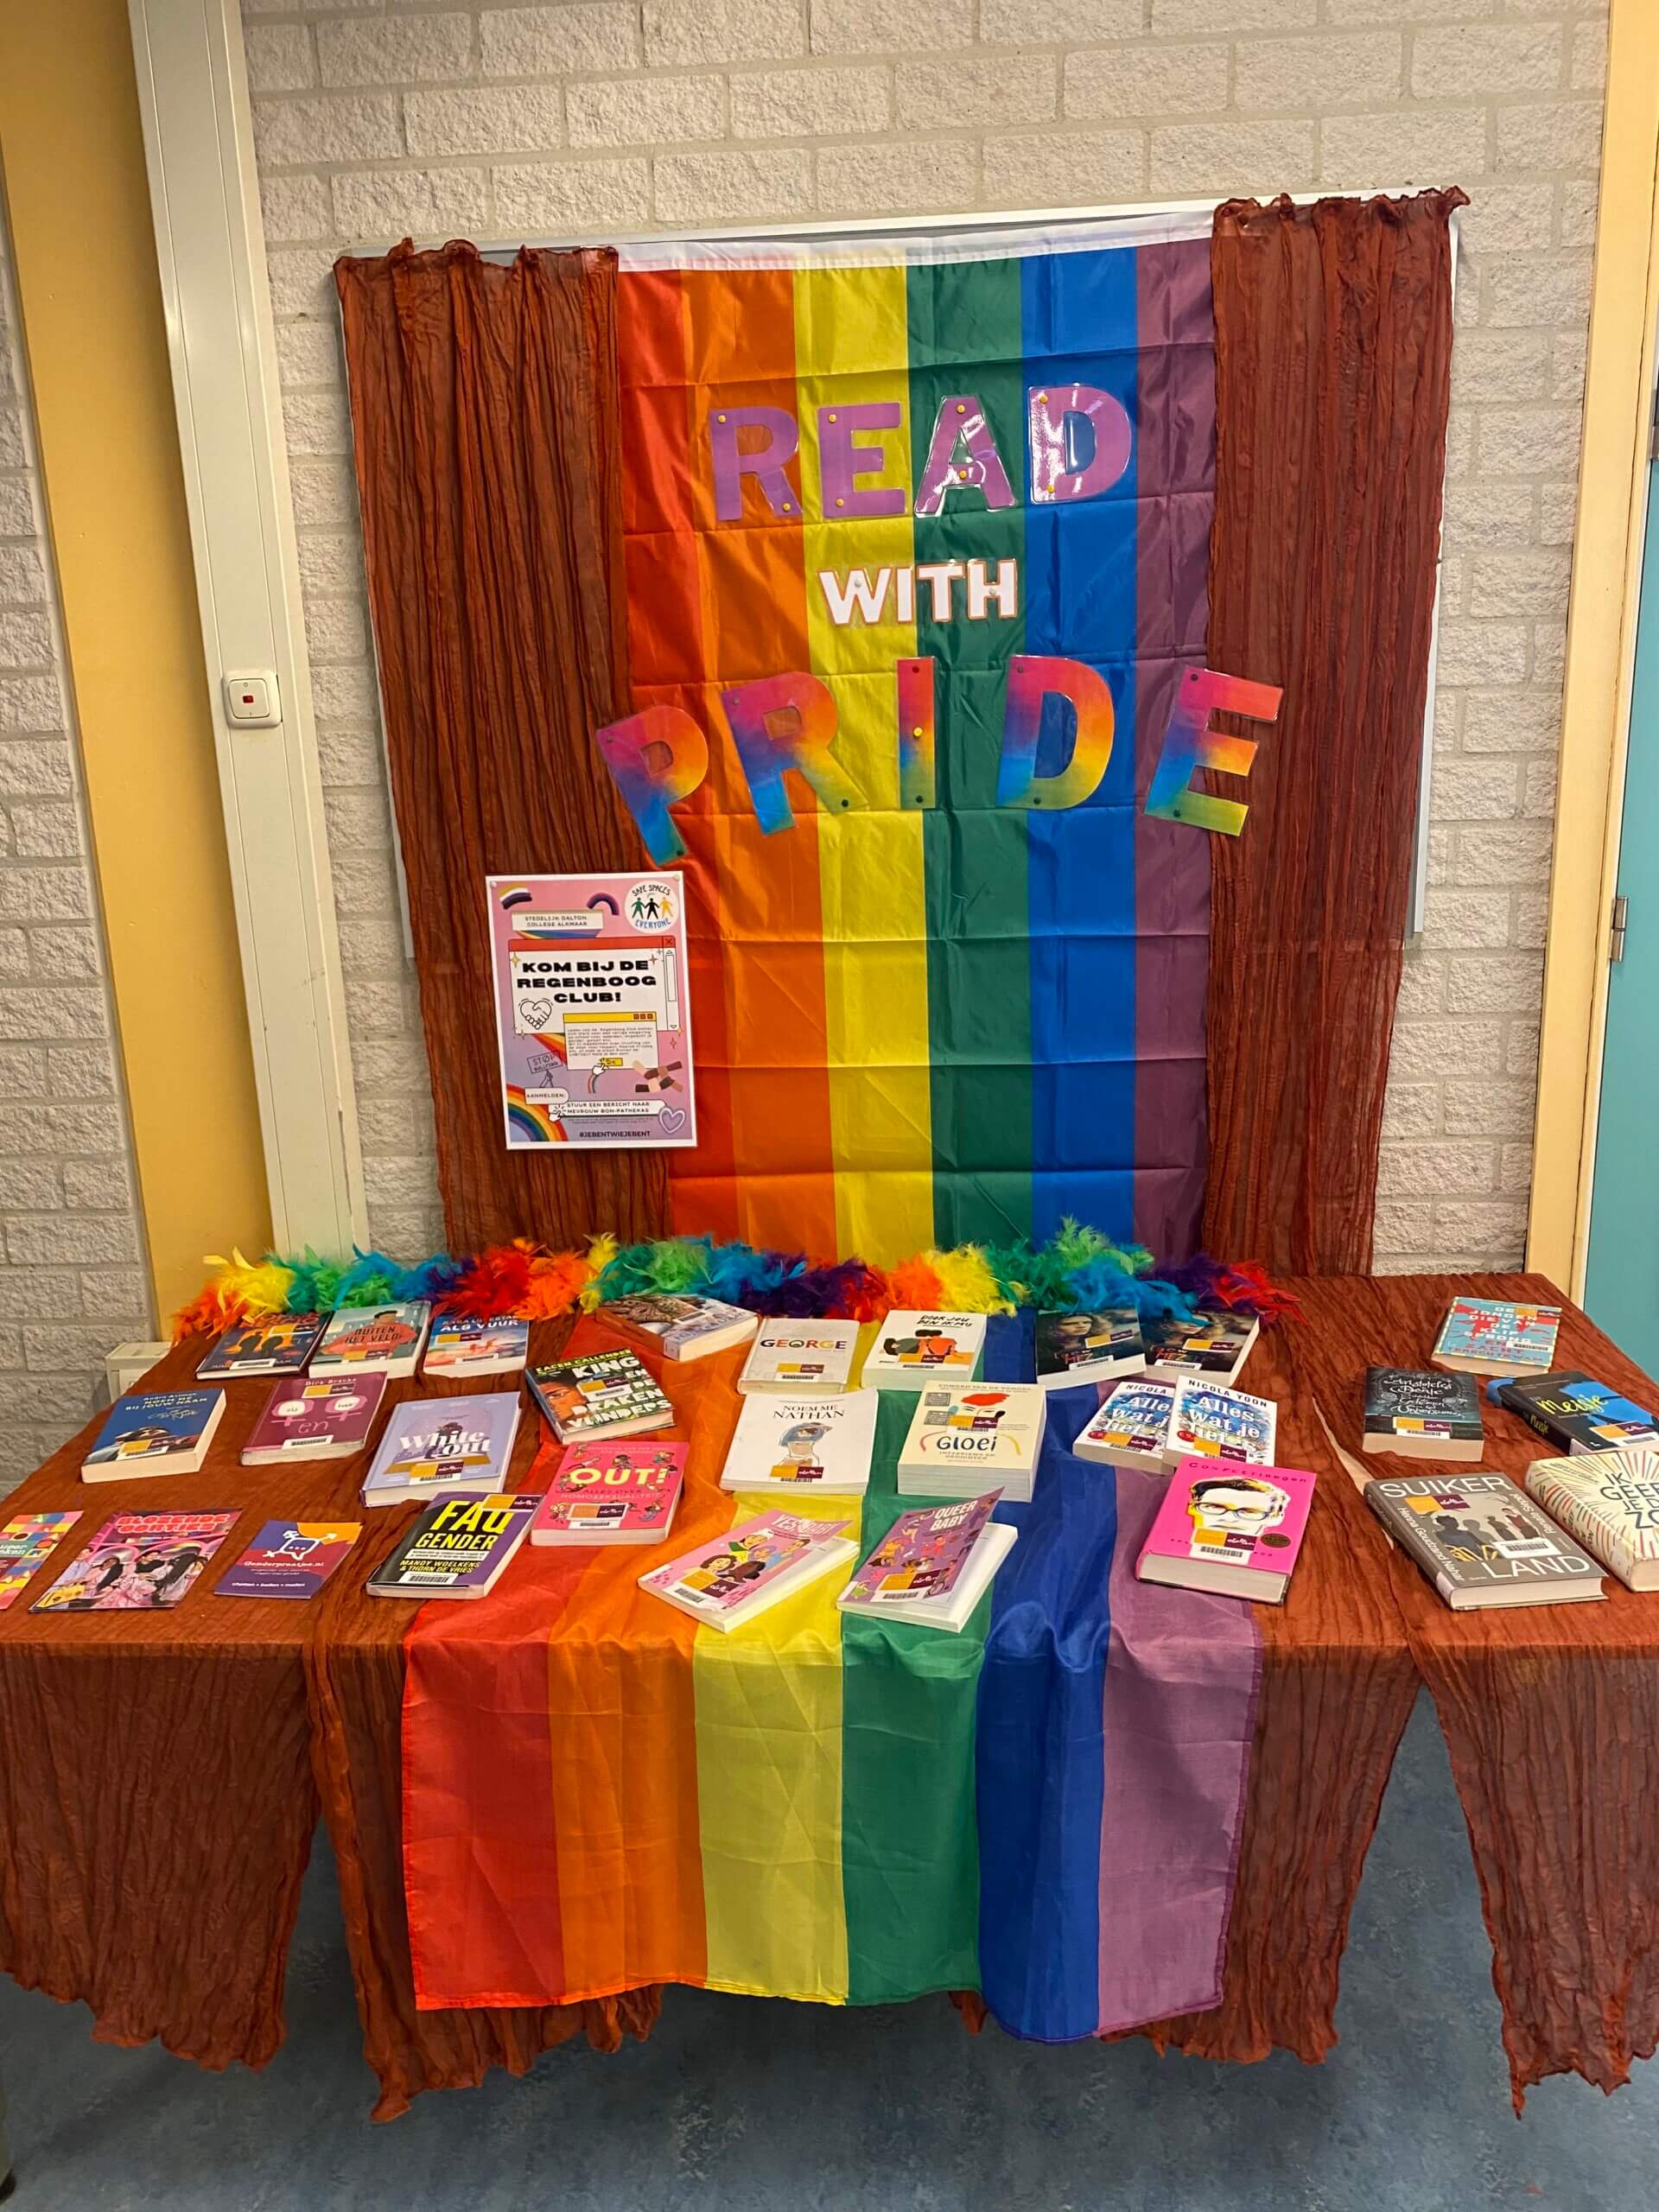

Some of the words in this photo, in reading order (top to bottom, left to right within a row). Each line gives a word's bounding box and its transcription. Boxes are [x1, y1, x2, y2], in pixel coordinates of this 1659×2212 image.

[709, 384, 1134, 520] READ
[817, 558, 1018, 626] WITH
[596, 654, 1284, 866] PRIDE
[632, 885, 647, 896] SAFE
[648, 884, 671, 896] SPACES
[635, 918, 671, 929] EVERYONE
[522, 962, 572, 973] KOM
[576, 960, 614, 972] BIJ
[620, 959, 649, 971] DE
[517, 976, 657, 989] REGENBOOG
[554, 992, 621, 1003] CLUB!
[477, 1319, 518, 1329] VUUR
[760, 1339, 847, 1349] GEORGE
[572, 1357, 640, 1378] KING
[625, 1369, 647, 1378] EN
[1126, 1384, 1166, 1395] NICOLA
[1189, 1380, 1230, 1396] NICOLA
[1237, 1394, 1267, 1408] YOON
[571, 1389, 664, 1415] DRAKEN
[1127, 1396, 1172, 1413] Alle
[1198, 1396, 1255, 1422] Alles
[1535, 1394, 1608, 1415] Meisje
[567, 1399, 671, 1427] VLINDERS
[773, 1410, 844, 1419] NATHAN
[1112, 1408, 1154, 1423] wat
[298, 1421, 329, 1433] en
[1189, 1408, 1232, 1431] wat
[1236, 1423, 1260, 1440] je
[399, 1430, 485, 1450] White
[442, 1438, 492, 1456] out
[569, 1467, 668, 1485] OUT!
[1605, 1472, 1632, 1485] IK
[1378, 1477, 1512, 1498] SUIKER
[934, 1500, 978, 1519] QUEER
[1623, 1500, 1644, 1511] JE
[429, 1500, 516, 1535] FAQ
[929, 1514, 968, 1531] BABY
[415, 1533, 499, 1550] GENDER
[1480, 1555, 1590, 1580] LAND
